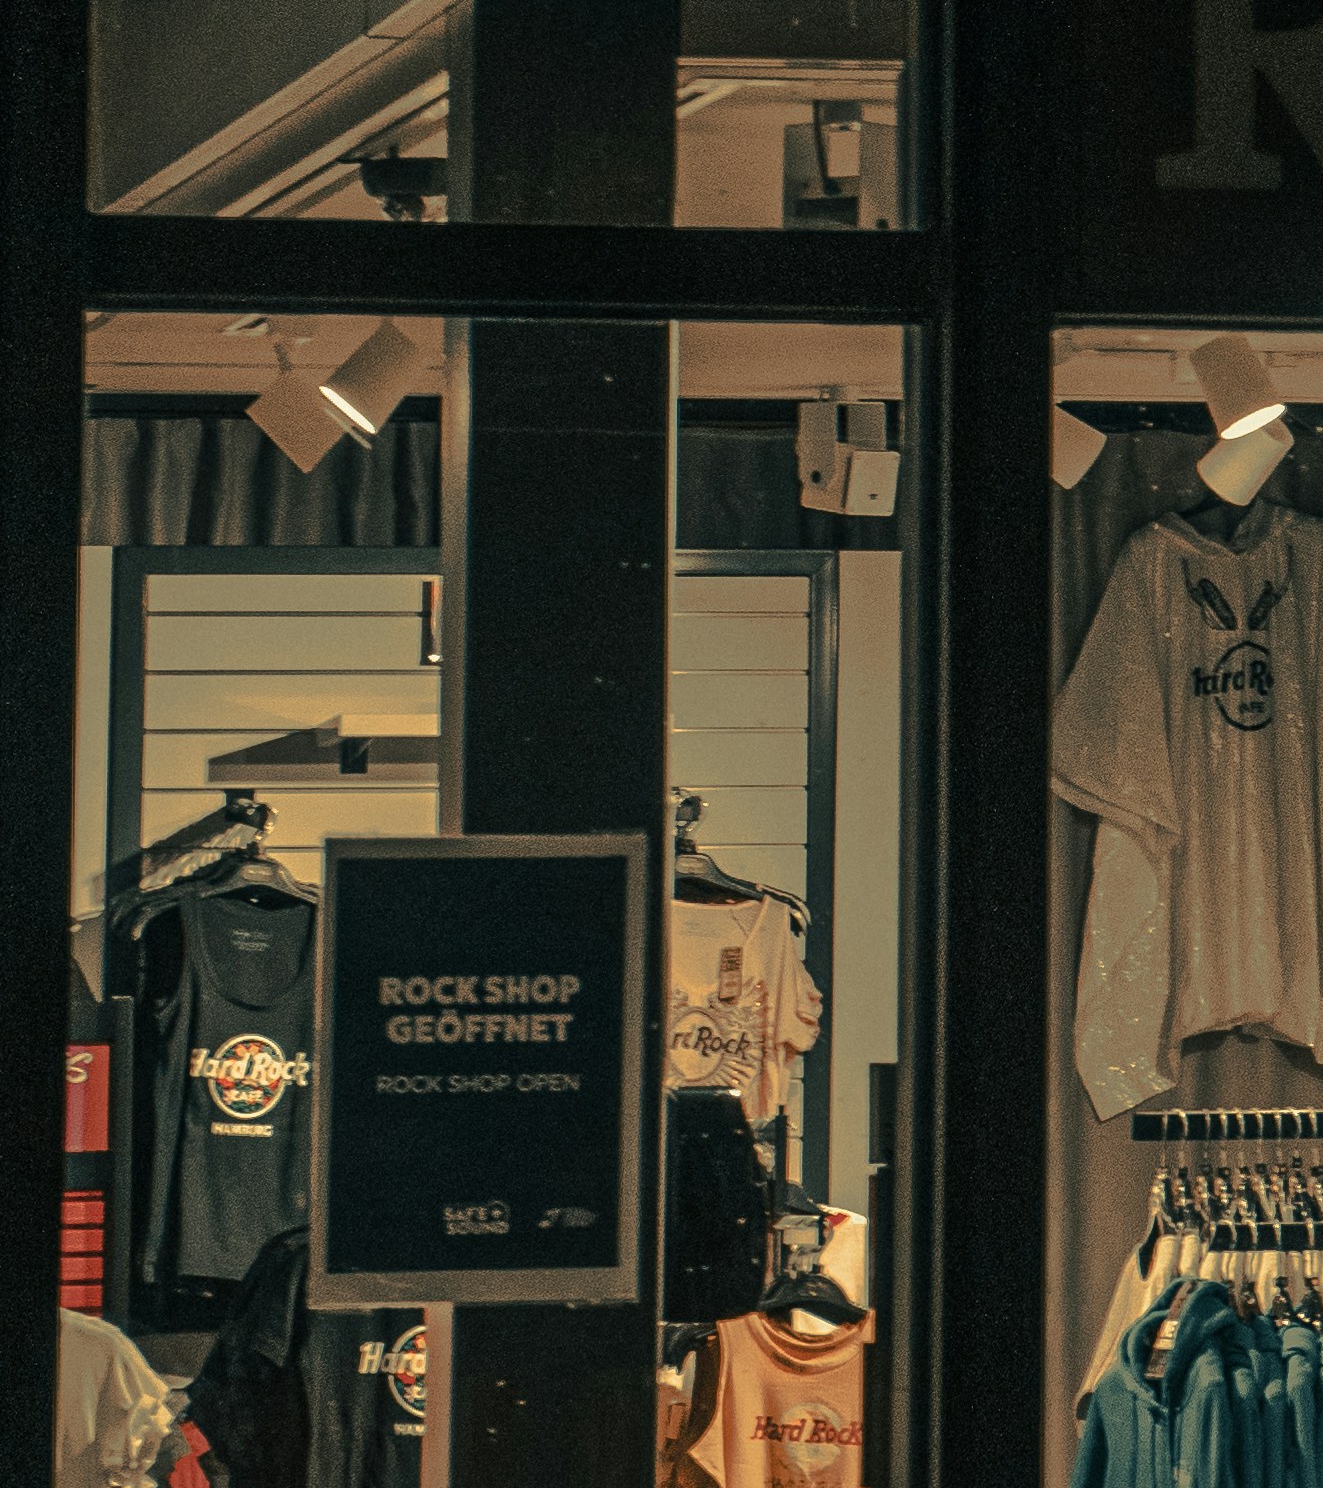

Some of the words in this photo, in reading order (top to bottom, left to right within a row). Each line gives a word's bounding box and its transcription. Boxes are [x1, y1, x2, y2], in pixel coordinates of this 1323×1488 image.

[378, 975, 481, 1007] ROCK
[482, 973, 582, 1005] SHOP
[385, 1007, 576, 1045] GEÖFFNET
[251, 1051, 311, 1088] Rock
[376, 1073, 444, 1095] ROCK
[446, 1073, 512, 1094] SHOP
[515, 1072, 582, 1093] OPEN
